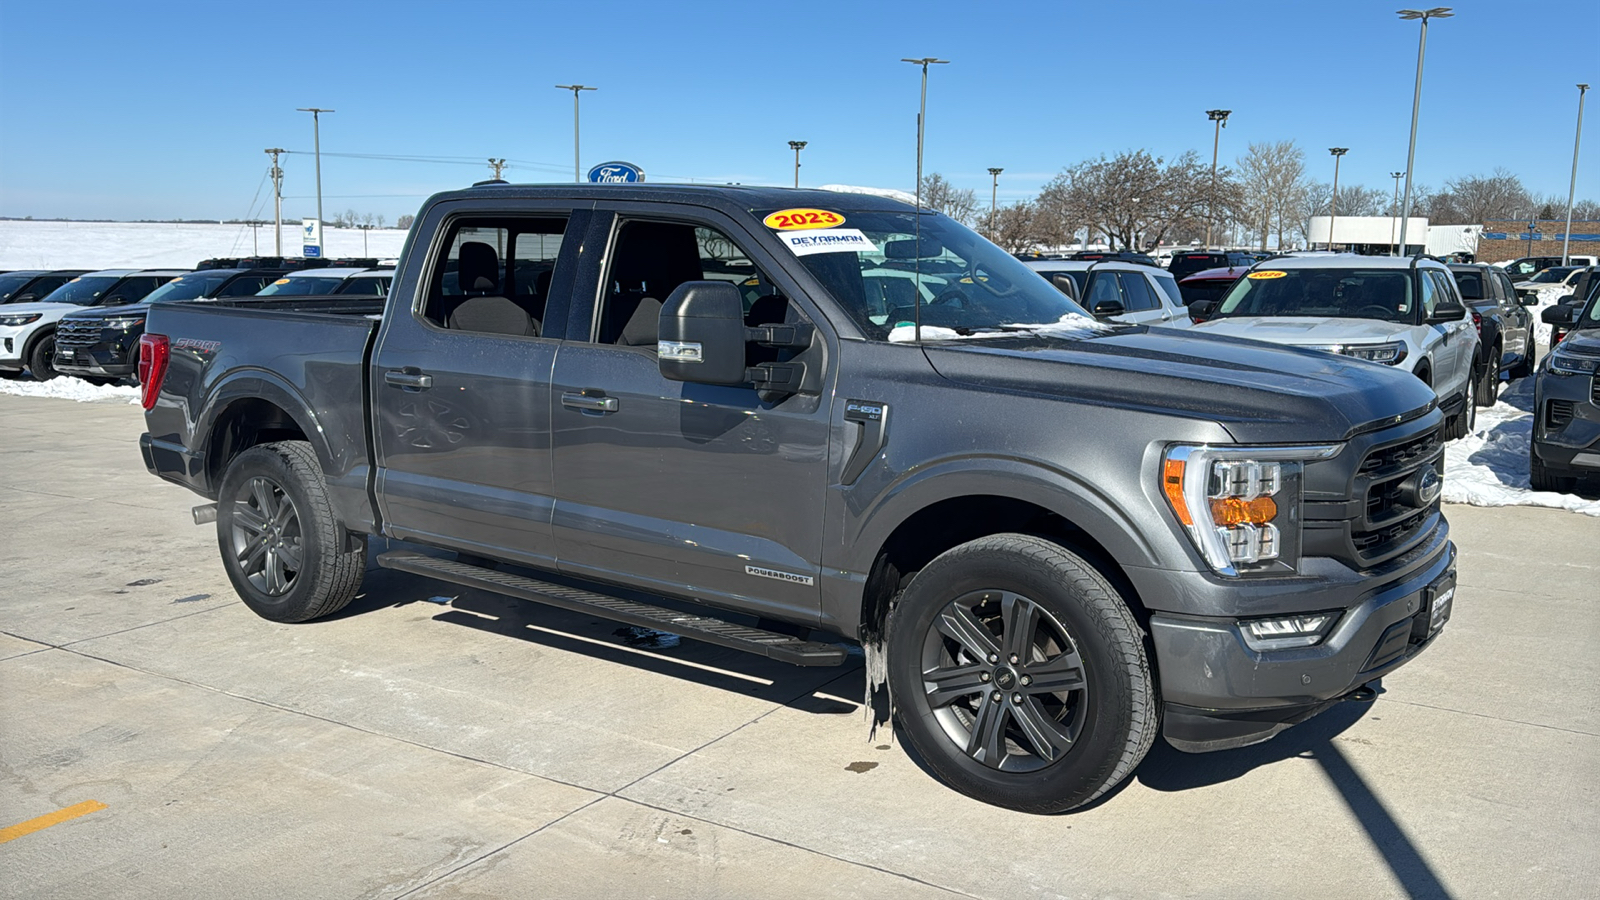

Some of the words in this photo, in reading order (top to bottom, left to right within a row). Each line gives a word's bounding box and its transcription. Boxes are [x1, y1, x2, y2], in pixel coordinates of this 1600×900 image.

[597, 167, 629, 183] Ford
[774, 212, 838, 228] 2023
[790, 235, 864, 245] DEYARMAN
[174, 337, 221, 350] SPORT
[847, 404, 882, 414] F-150
[747, 567, 810, 583] POWERBOOST
